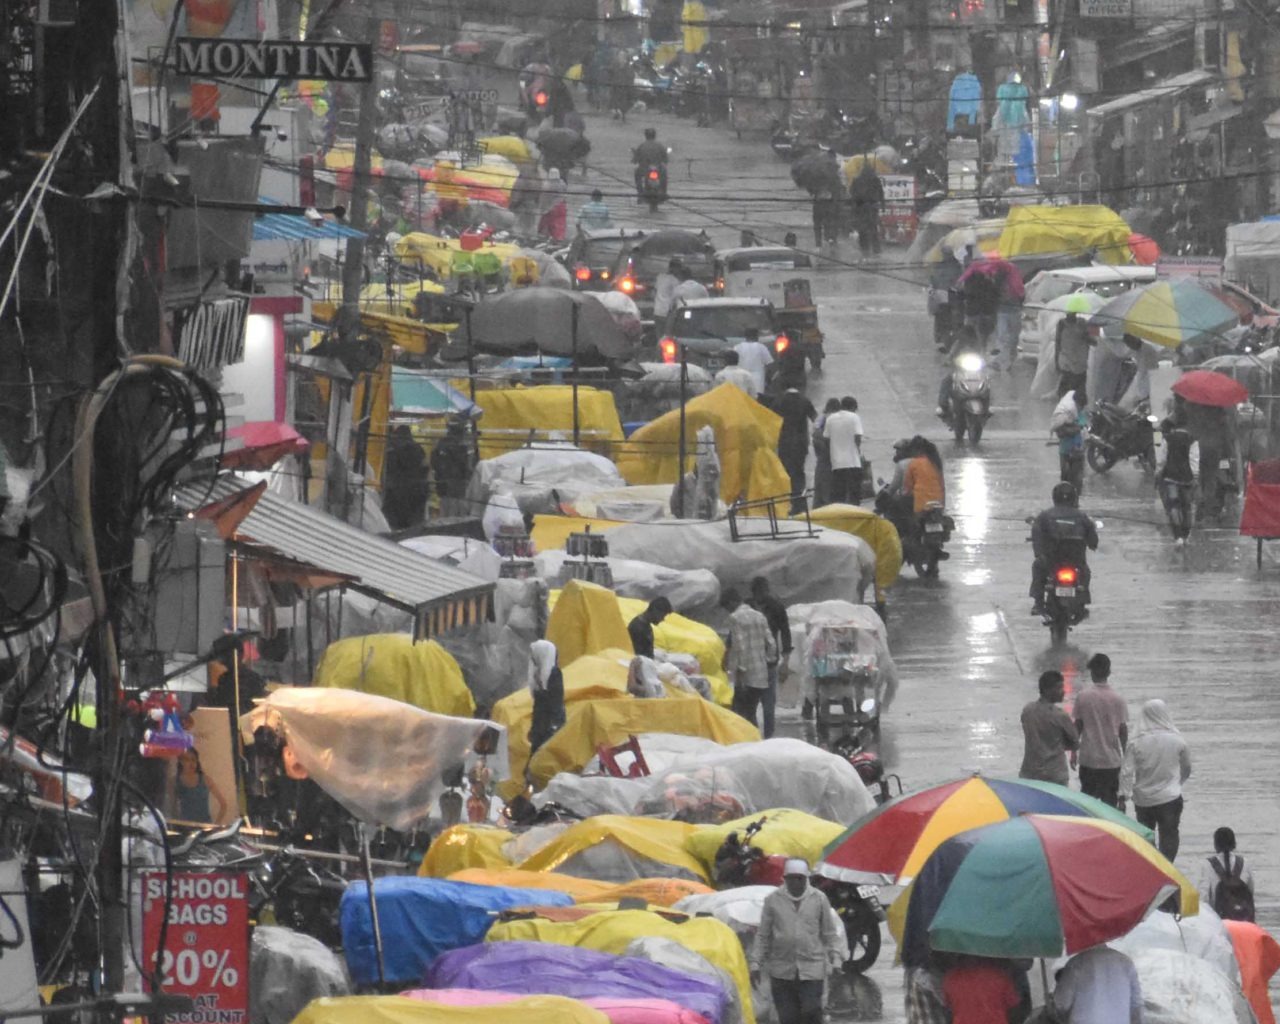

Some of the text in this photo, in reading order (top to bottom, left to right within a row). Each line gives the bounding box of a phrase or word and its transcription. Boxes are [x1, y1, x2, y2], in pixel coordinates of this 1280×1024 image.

[178, 42, 366, 78] MONTINA
[148, 878, 244, 899] SCHOOL
[166, 904, 228, 925] BAGS
[151, 949, 239, 987] 20%
